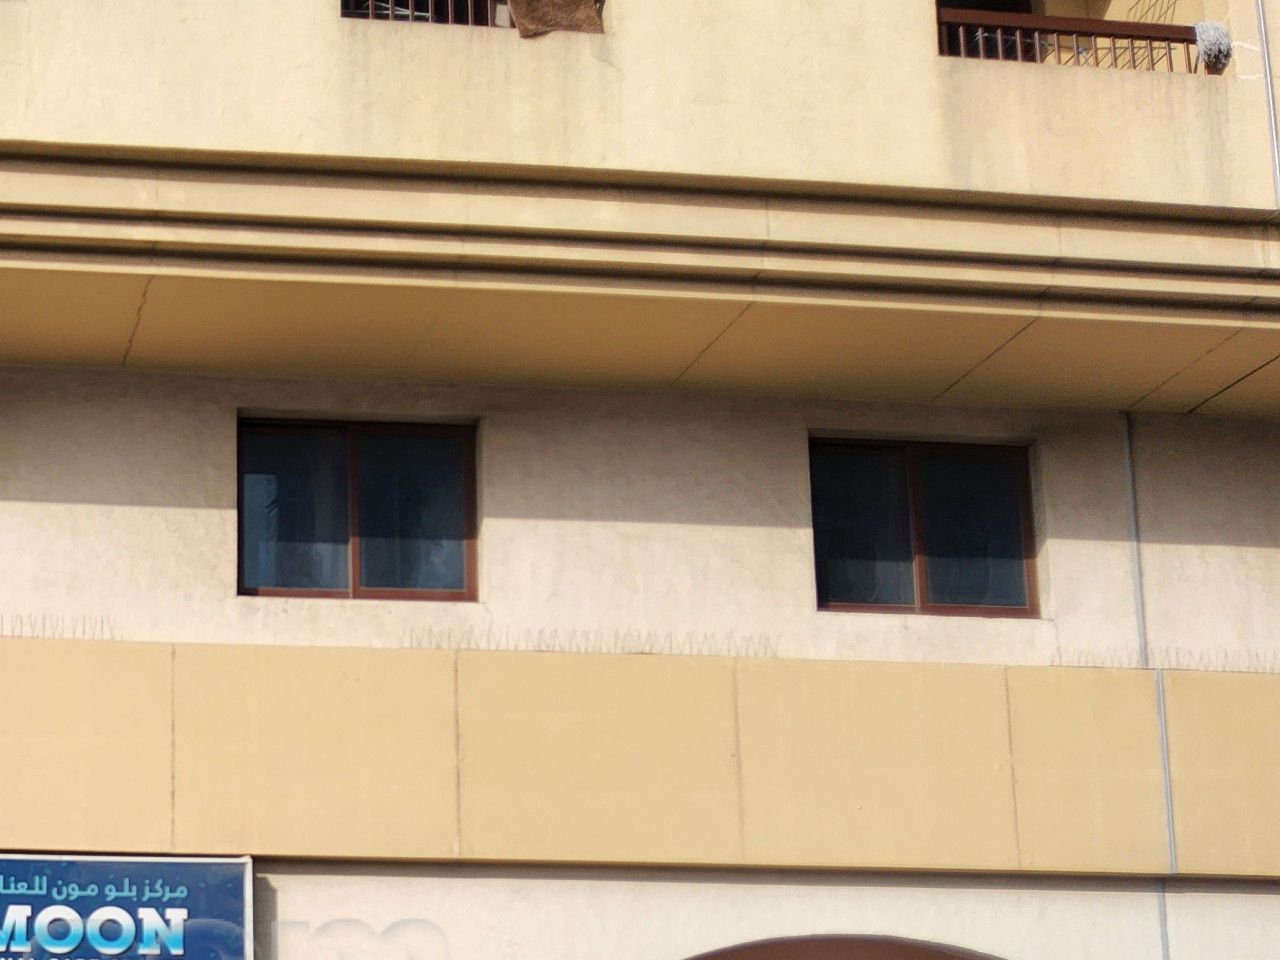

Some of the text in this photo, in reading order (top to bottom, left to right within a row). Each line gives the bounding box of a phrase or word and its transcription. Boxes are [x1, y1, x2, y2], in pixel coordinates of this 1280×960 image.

[52, 879, 99, 901] مون
[104, 876, 137, 901] بلو
[142, 878, 188, 902] مركز
